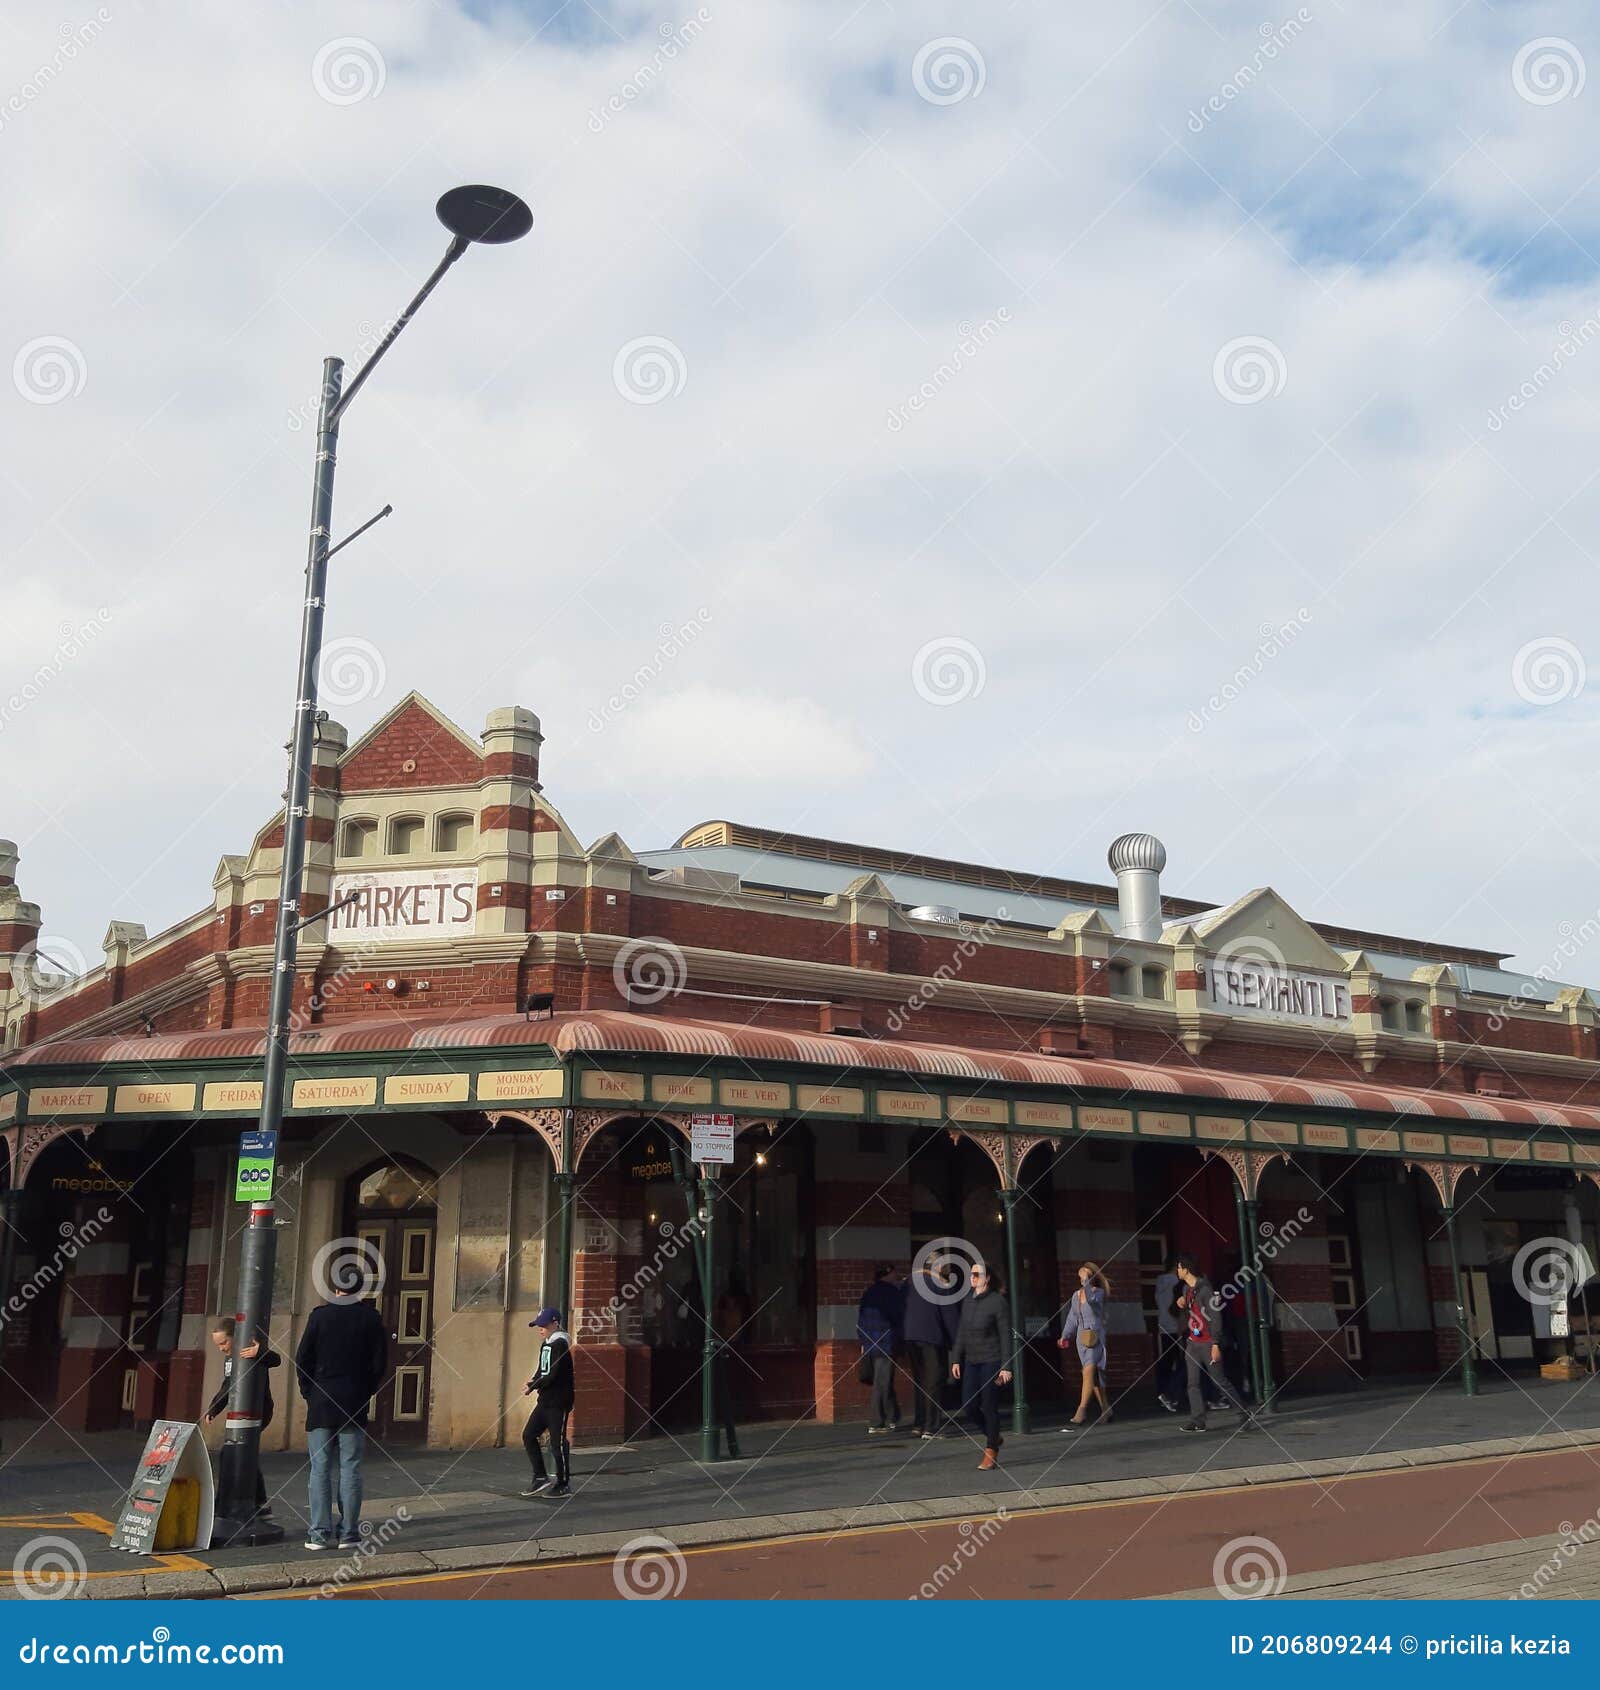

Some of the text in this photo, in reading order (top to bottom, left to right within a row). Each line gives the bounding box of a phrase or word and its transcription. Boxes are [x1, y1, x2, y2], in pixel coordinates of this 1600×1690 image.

[332, 883, 473, 929] MARKETS
[1212, 969, 1347, 1019] FREMANTLE
[496, 1084, 543, 1097] HOLIDAY
[497, 1072, 543, 1084] MONDAY
[41, 1094, 94, 1107] MARKET
[138, 1092, 172, 1104] OPEN
[298, 1084, 369, 1100] SATURDAY
[400, 1080, 453, 1096] SUNDAY
[597, 1077, 628, 1092] TAKE
[668, 1085, 695, 1096] HOME
[730, 1088, 748, 1099] THE
[755, 1090, 780, 1101] VERY
[819, 1095, 841, 1105] BEST
[890, 1100, 928, 1112] QUALITY
[965, 1105, 991, 1116] FRESH
[1157, 1120, 1171, 1129] ALL
[632, 1160, 672, 1180] megabes
